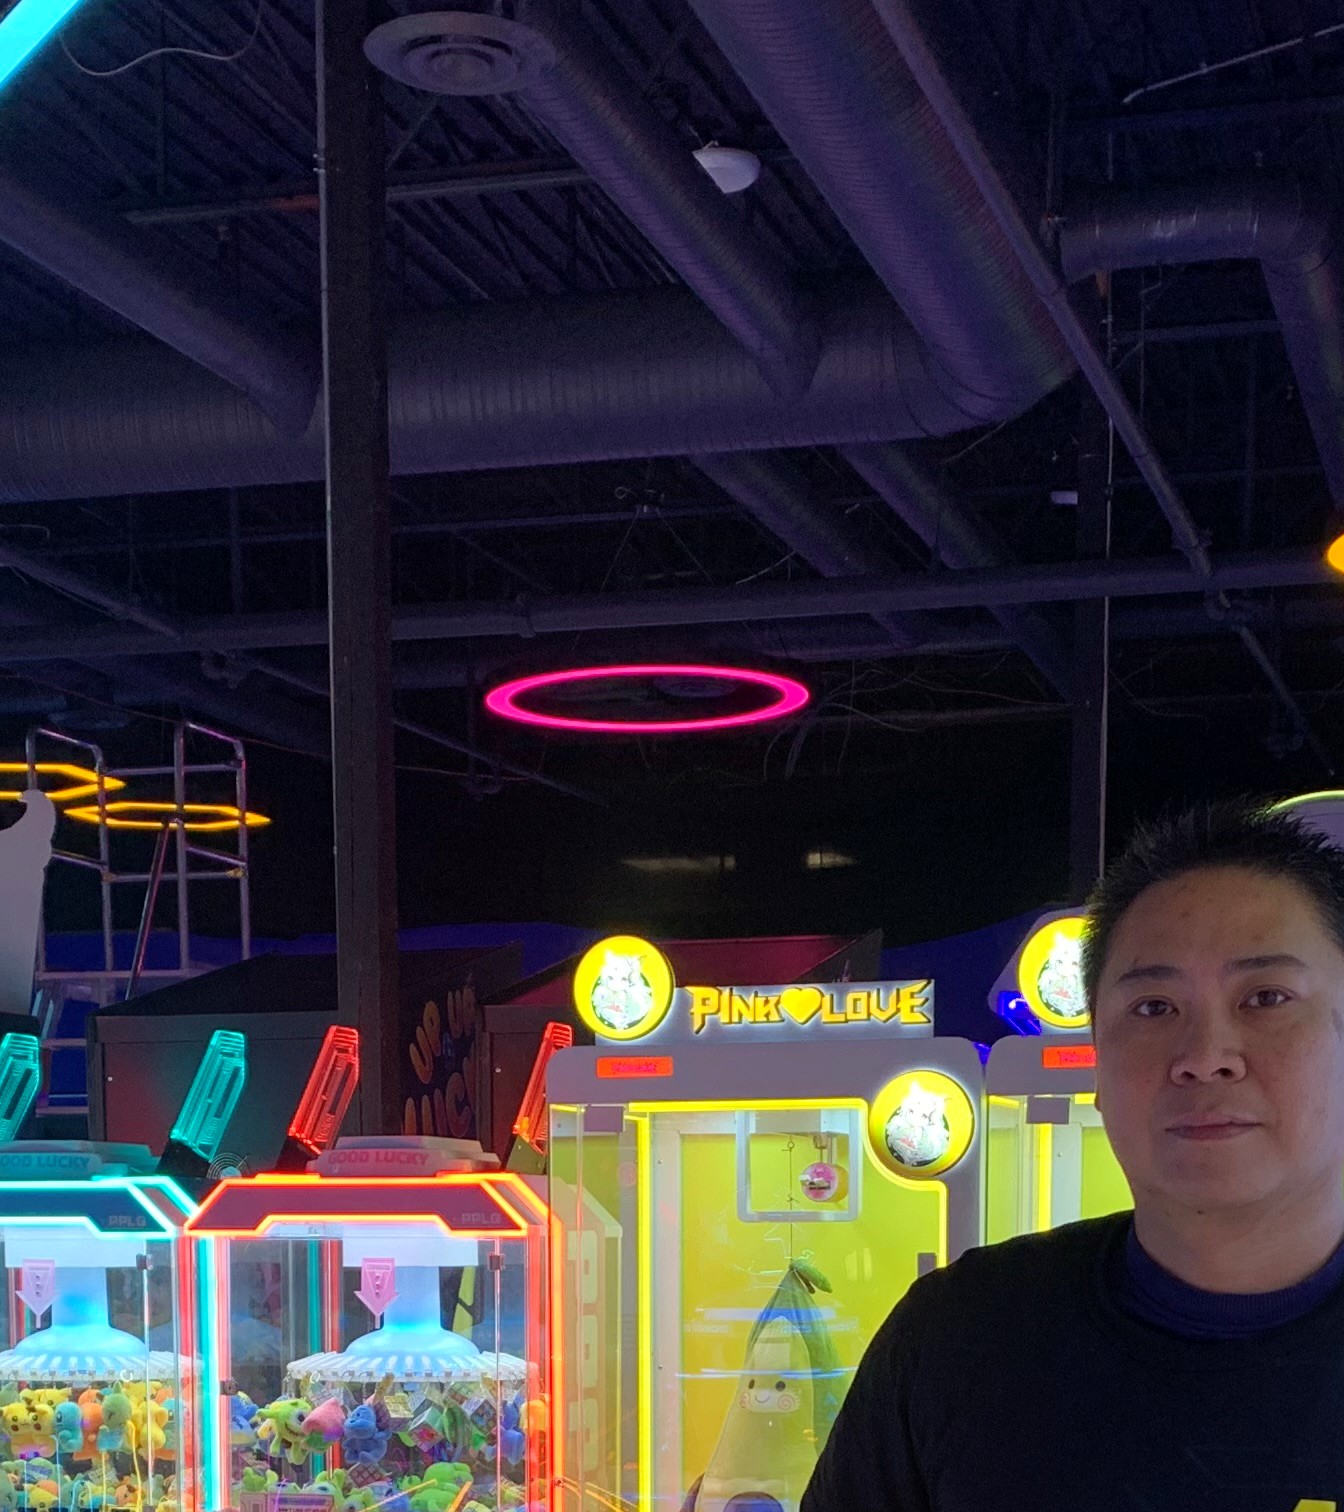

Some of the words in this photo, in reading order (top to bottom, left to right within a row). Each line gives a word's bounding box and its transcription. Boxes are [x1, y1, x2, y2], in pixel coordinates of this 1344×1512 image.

[686, 985, 783, 1035] PINK
[822, 979, 932, 1024] LOVE
[36, 1155, 90, 1169] LUCKY
[327, 1151, 369, 1165] GOOD
[375, 1152, 430, 1166] LUCKY
